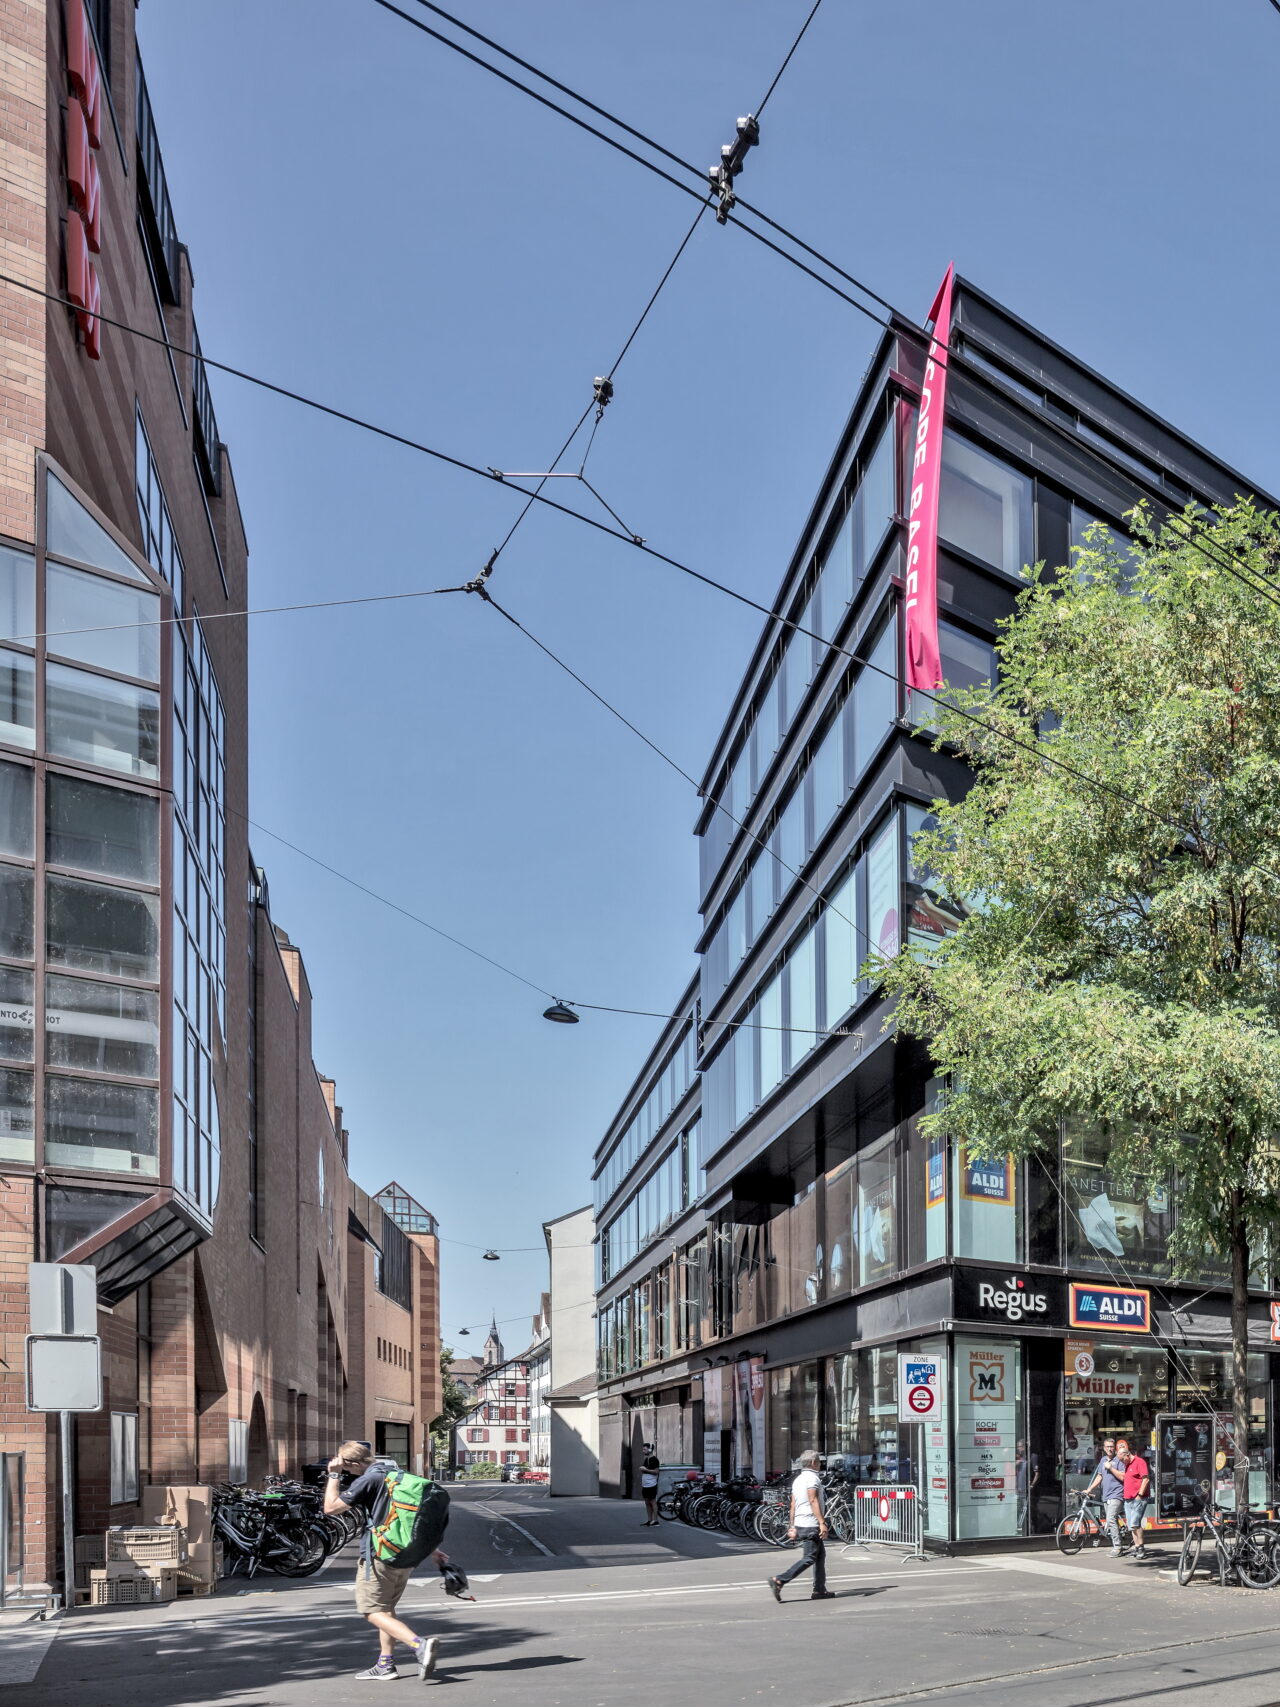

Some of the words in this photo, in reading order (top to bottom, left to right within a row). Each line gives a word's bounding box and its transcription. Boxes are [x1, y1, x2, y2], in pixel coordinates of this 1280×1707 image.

[971, 1172, 1004, 1189] ALDI
[983, 1187, 1005, 1197] SUISSE
[979, 1283, 1047, 1320] Regus
[1099, 1297, 1142, 1317] ALDI
[1099, 1314, 1119, 1322] SUISSE
[969, 1351, 1005, 1361] Müller
[978, 1373, 997, 1391] M
[1075, 1377, 1135, 1395] Müller
